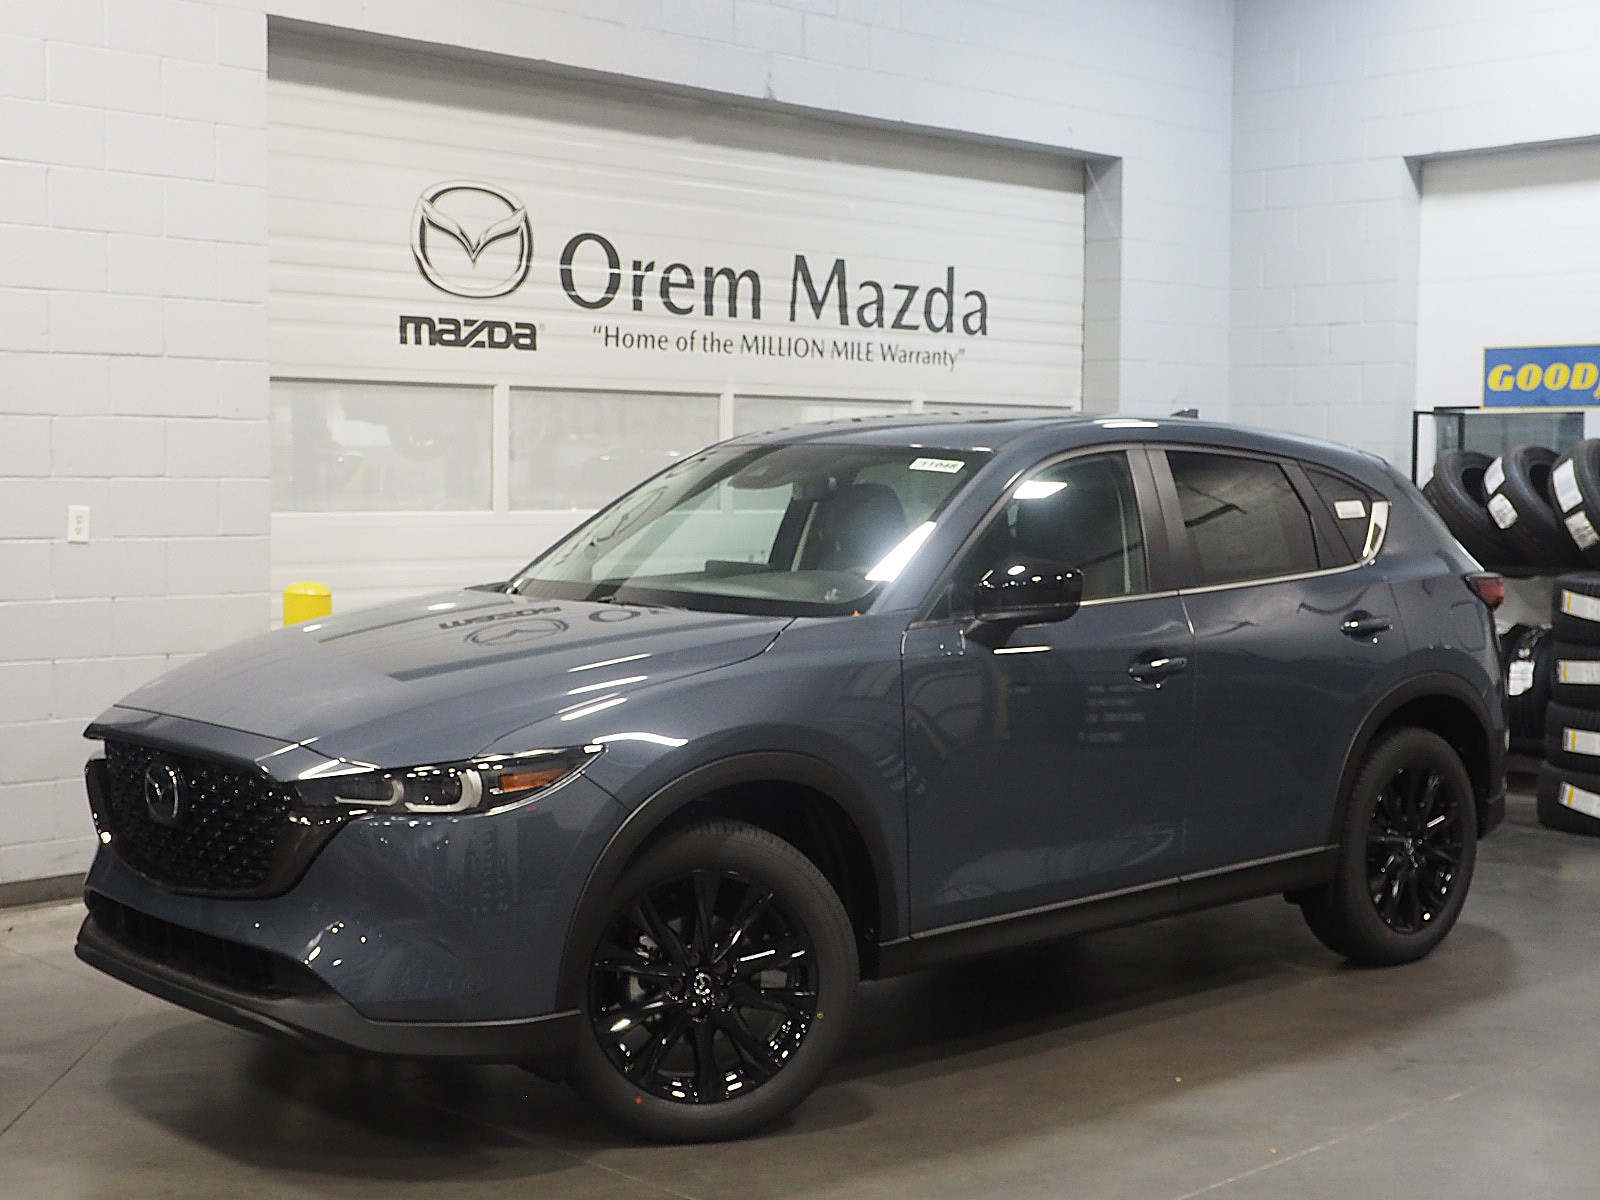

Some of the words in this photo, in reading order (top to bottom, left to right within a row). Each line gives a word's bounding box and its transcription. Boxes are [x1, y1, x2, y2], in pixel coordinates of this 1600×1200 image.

[559, 232, 761, 320] Orem
[789, 254, 987, 336] Mazda
[676, 330, 697, 352] of
[702, 331, 734, 354] the
[740, 334, 825, 358] MILLION
[831, 340, 874, 361] MILE
